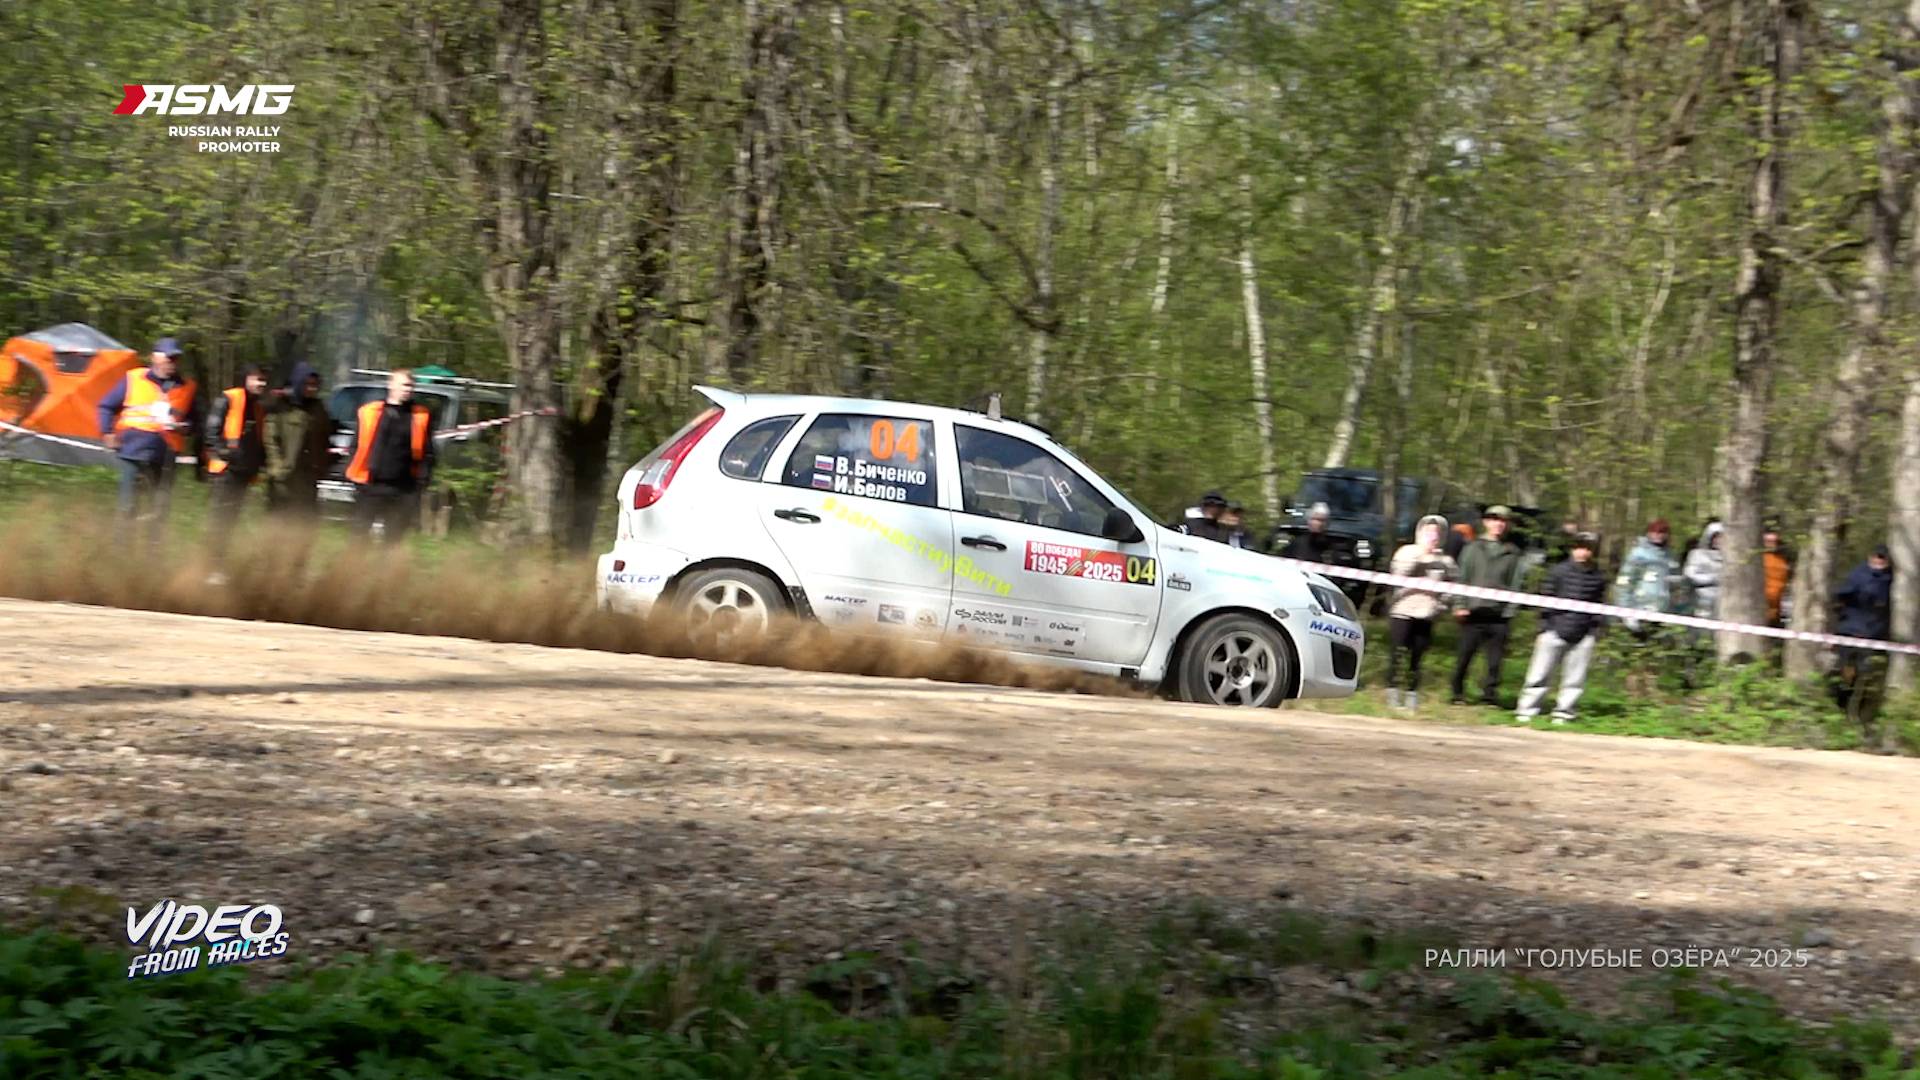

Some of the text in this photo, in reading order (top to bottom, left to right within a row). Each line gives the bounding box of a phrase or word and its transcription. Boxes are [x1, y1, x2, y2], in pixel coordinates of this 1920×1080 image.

[869, 419, 919, 462] 04
[835, 456, 927, 485] В.Биченко
[834, 474, 906, 501] И.Белов
[1030, 554, 1123, 582] 1945 2025
[1126, 556, 1156, 584] 04
